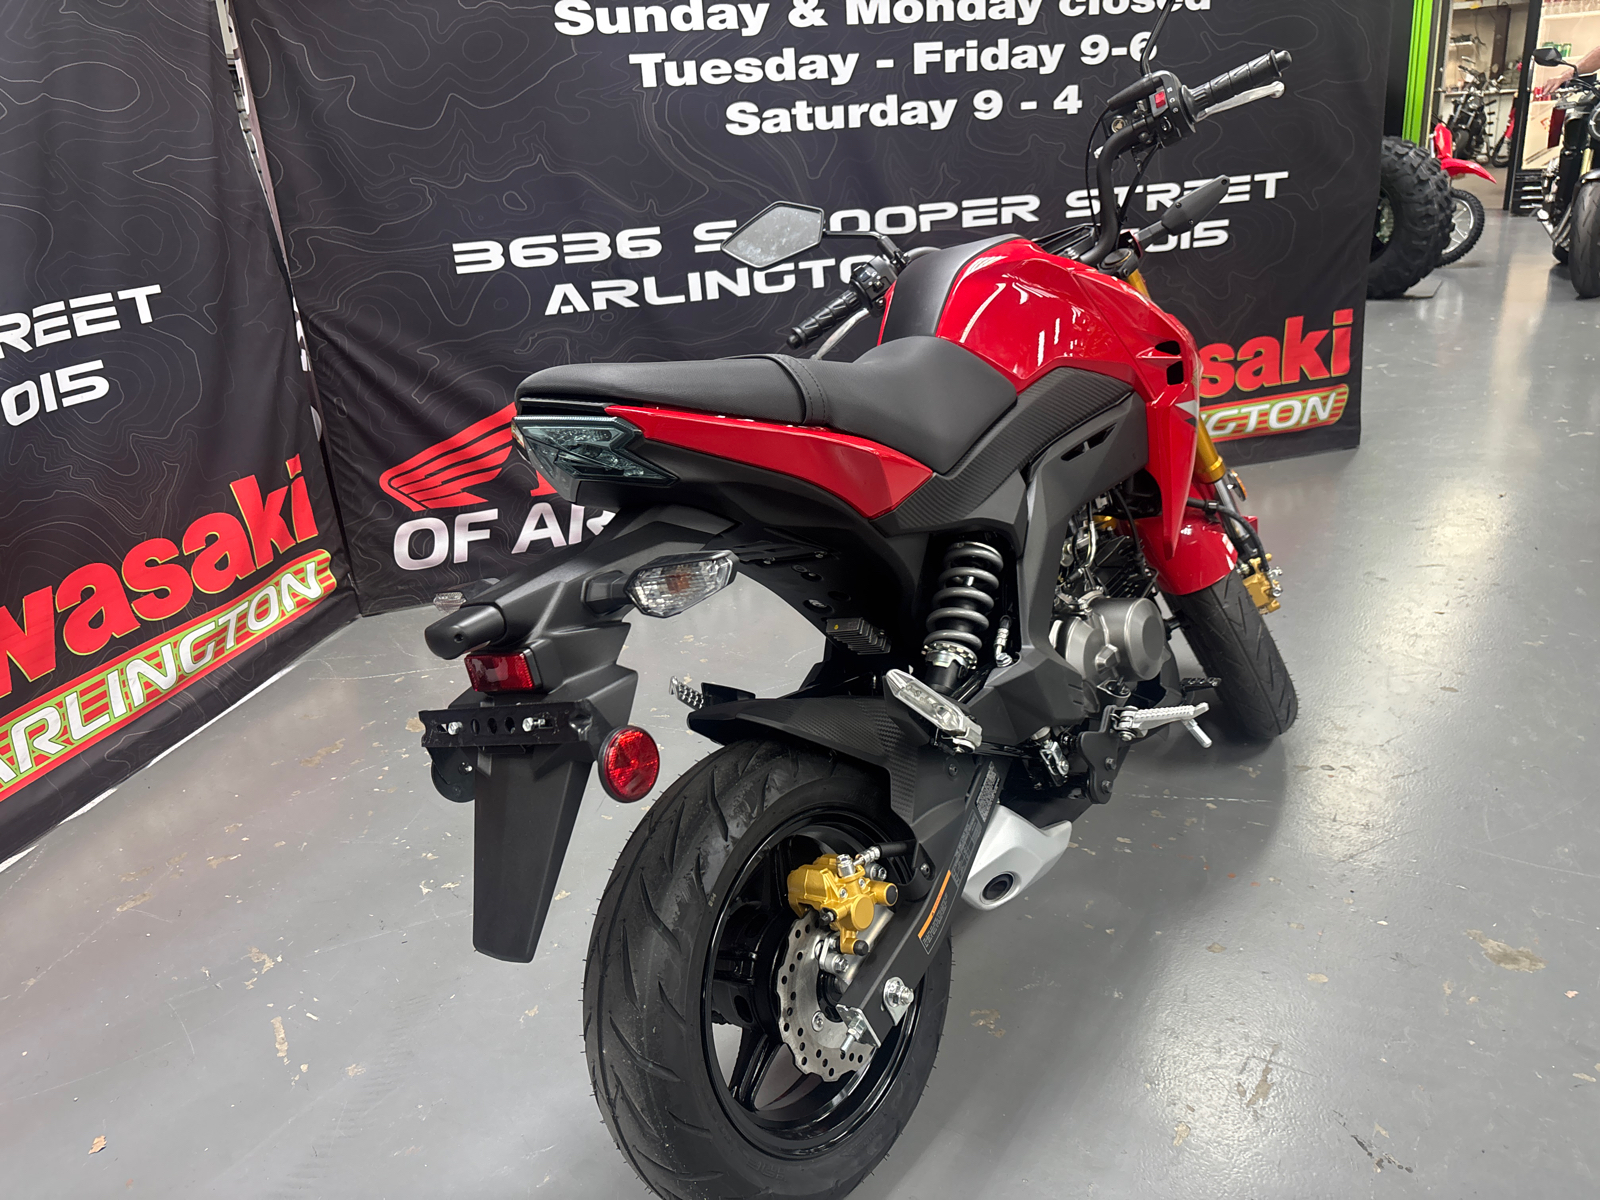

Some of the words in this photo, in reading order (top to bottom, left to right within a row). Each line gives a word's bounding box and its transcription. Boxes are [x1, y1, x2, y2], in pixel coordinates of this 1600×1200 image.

[554, 0, 770, 36] Sunday
[788, 0, 829, 28] &
[845, 0, 1042, 26] Monday
[628, 47, 860, 88] Tuesday
[875, 58, 895, 69] -
[913, 38, 1066, 75] Friday
[1080, 31, 1158, 66] 9-6
[725, 90, 958, 136] Saturday
[972, 89, 1004, 121] 9
[1020, 100, 1038, 111] -
[1053, 84, 1083, 115] 4
[452, 226, 663, 275] 3636
[828, 194, 1041, 235] OOPER
[1200, 391, 1336, 437] GTON
[393, 507, 499, 571] OF
[0, 453, 320, 700] wasaki
